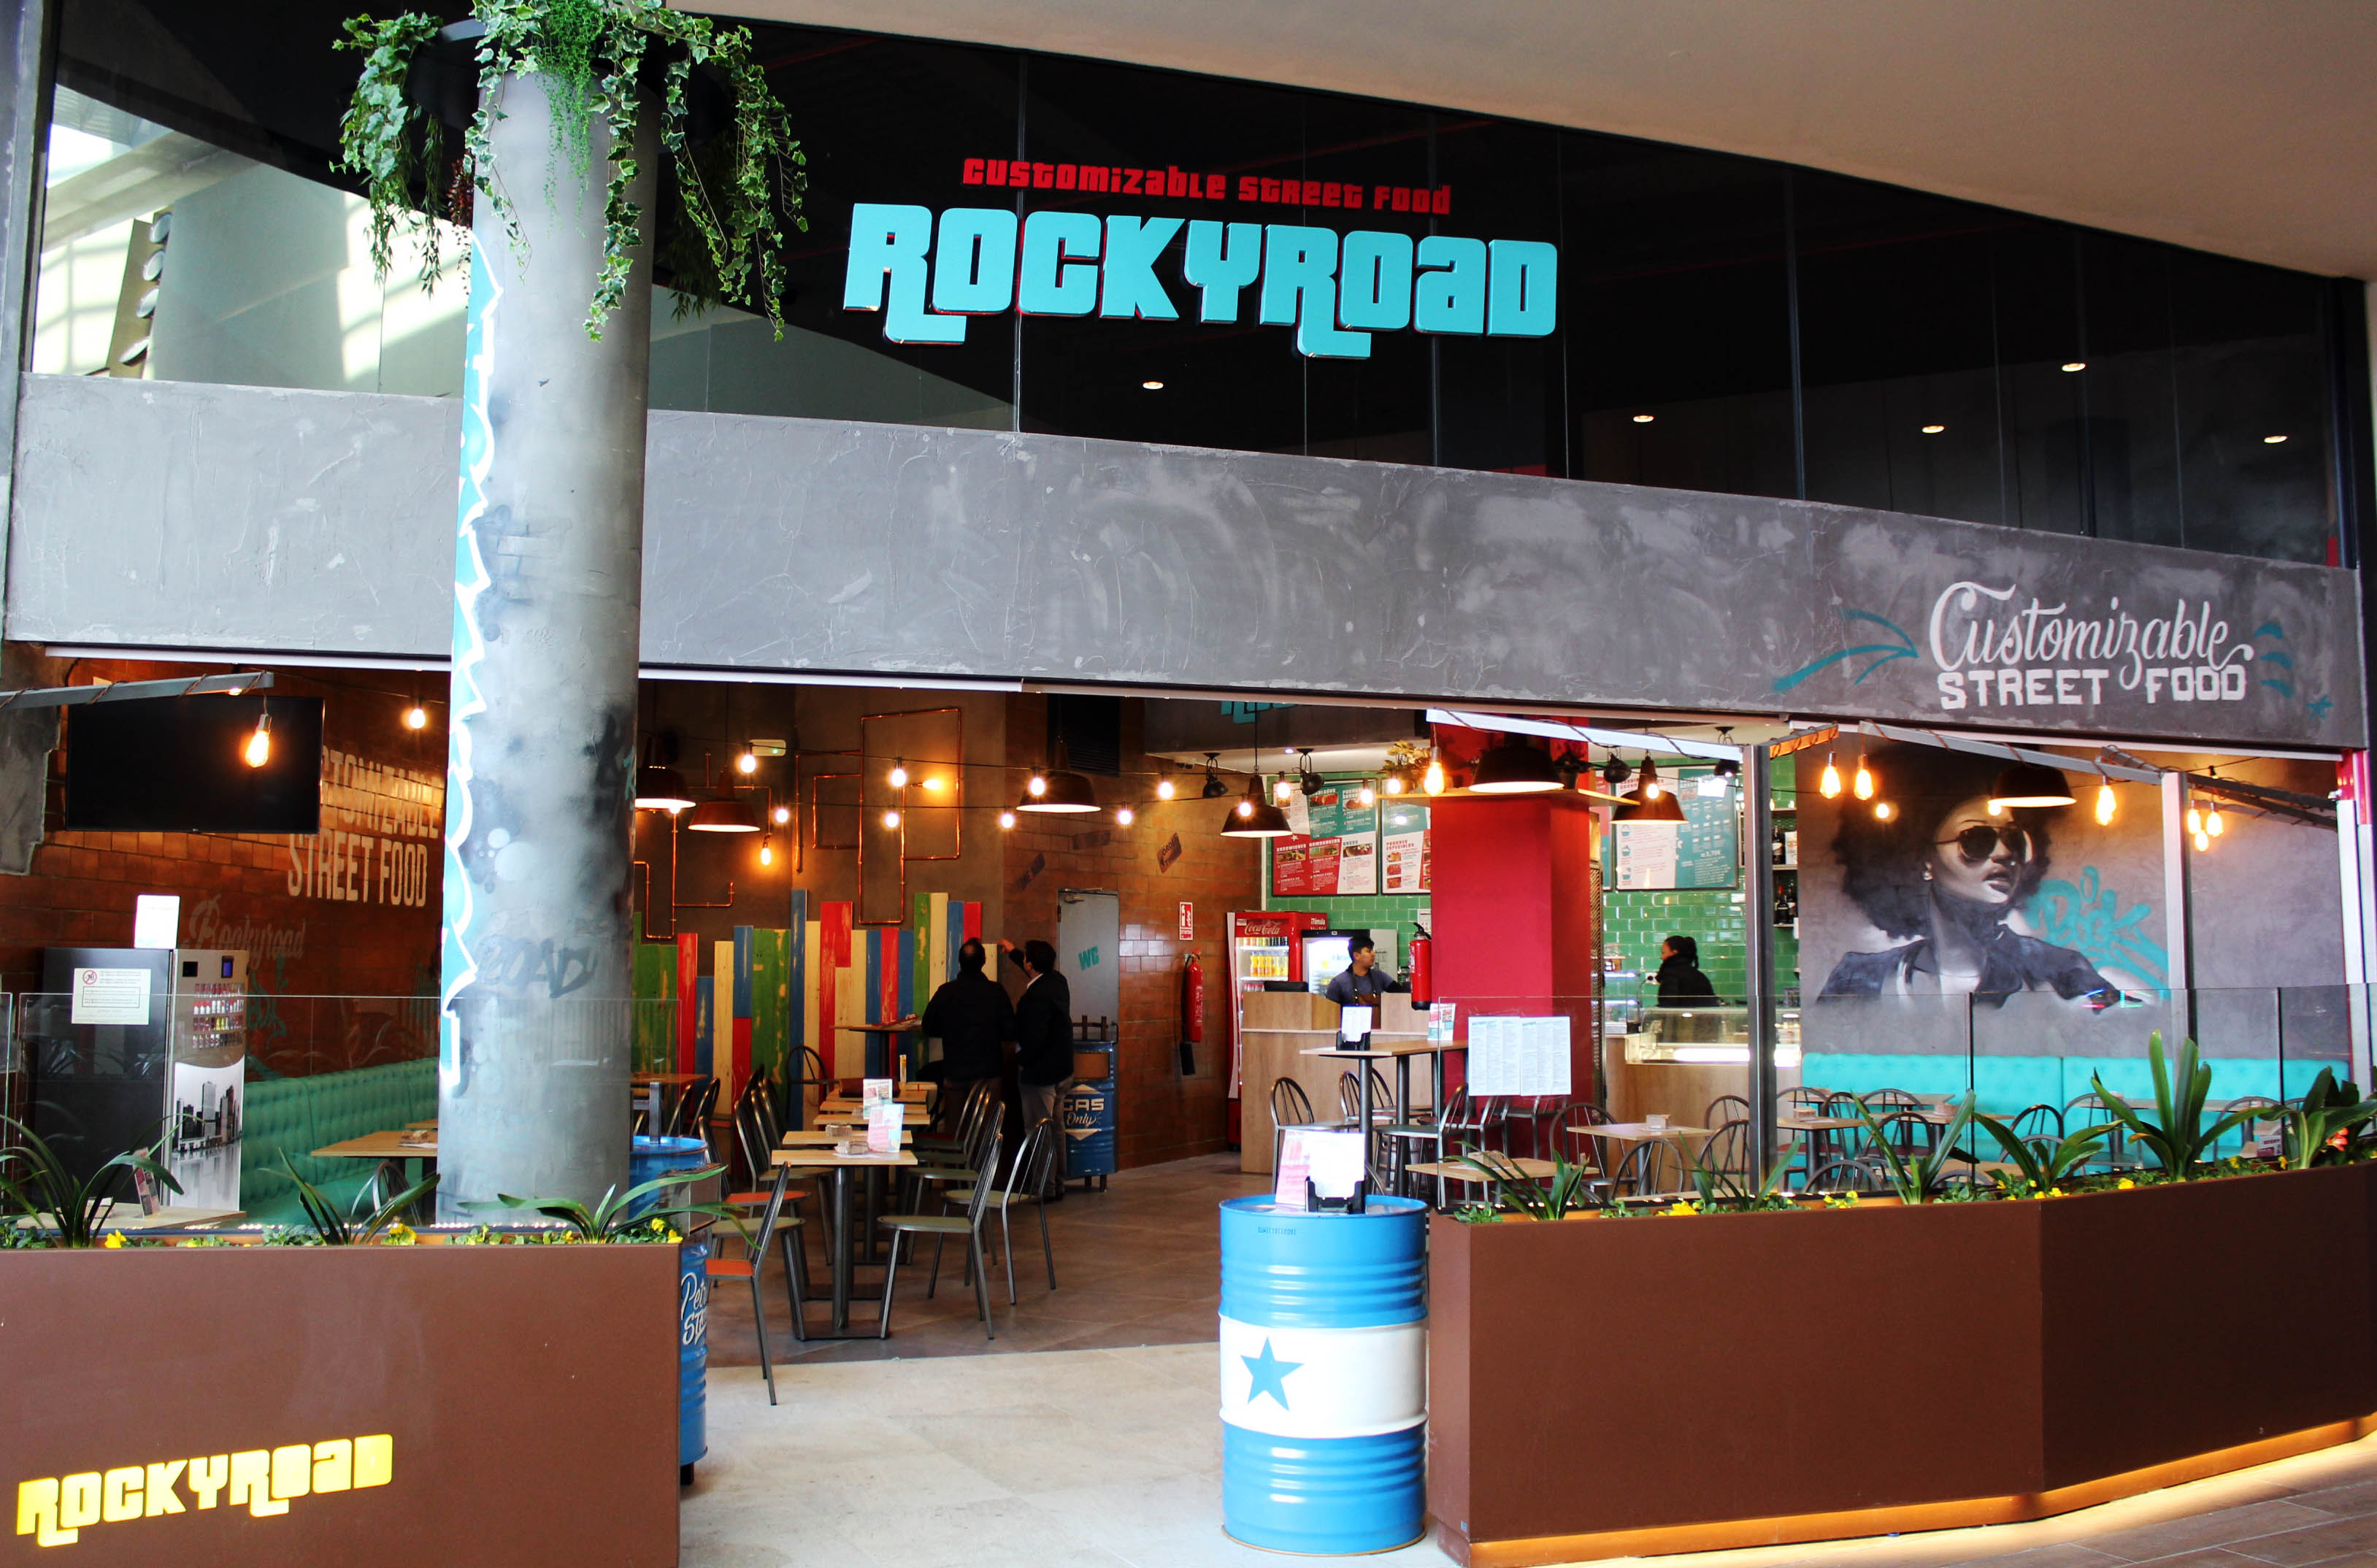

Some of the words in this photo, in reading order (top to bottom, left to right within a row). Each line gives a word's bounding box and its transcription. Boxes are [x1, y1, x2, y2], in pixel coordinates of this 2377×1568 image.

[1928, 580, 2254, 690] Customizable
[1938, 669, 2108, 710] STREET
[2145, 664, 2247, 704] FOOD
[287, 827, 375, 903] STREET
[379, 838, 428, 907] FOOD
[1078, 946, 1100, 971] WC
[1064, 1098, 1105, 1111] GAS
[1067, 1112, 1095, 1128] Only
